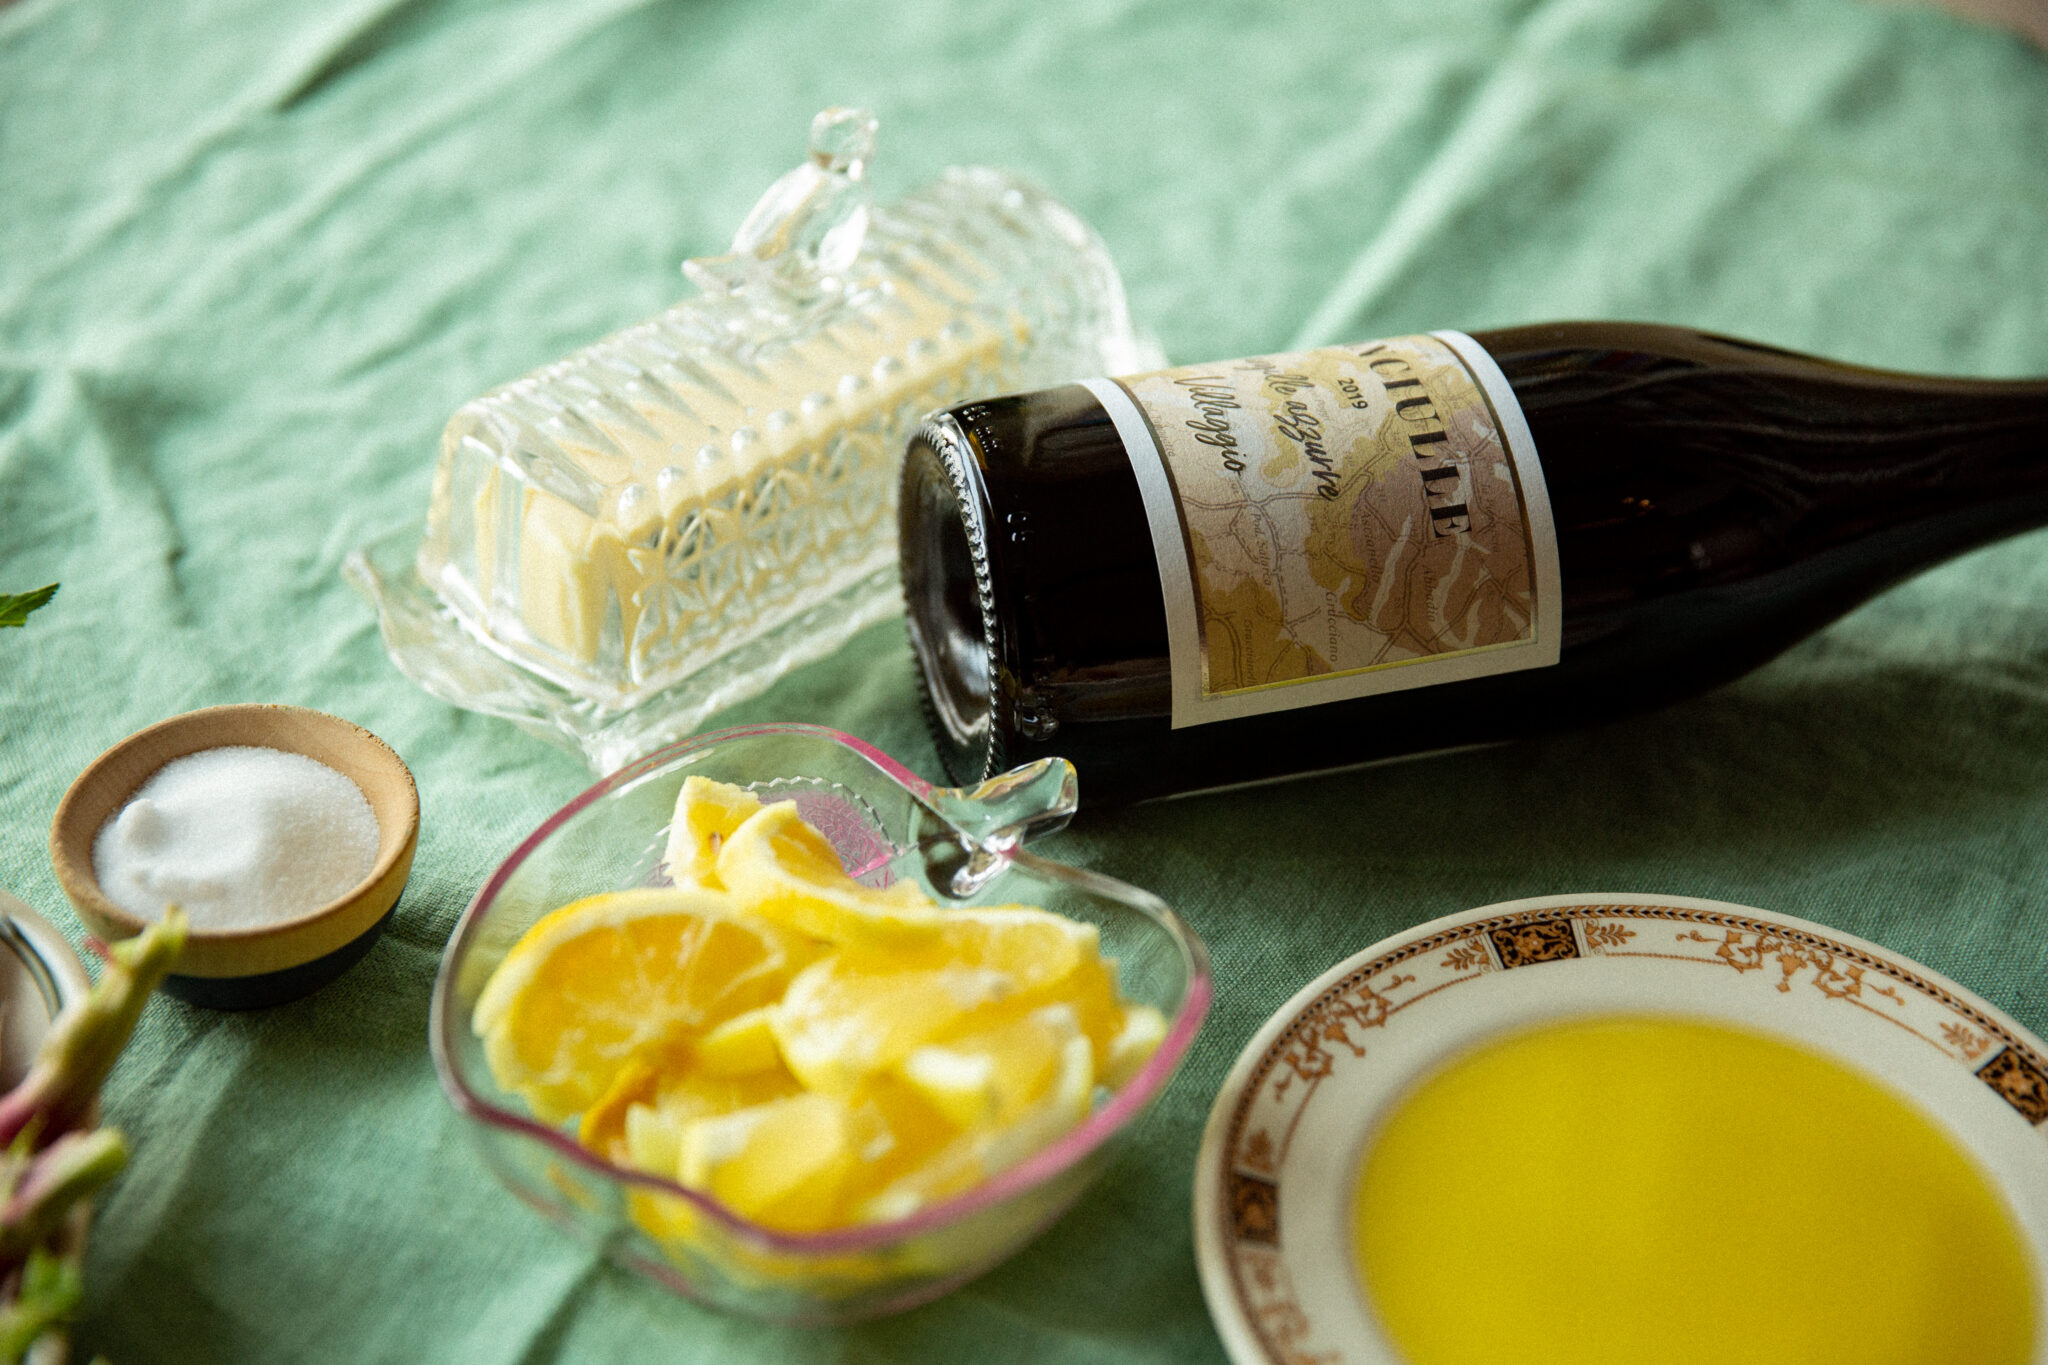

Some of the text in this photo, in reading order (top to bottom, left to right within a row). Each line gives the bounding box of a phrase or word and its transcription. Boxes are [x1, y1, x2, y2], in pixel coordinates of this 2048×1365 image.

[1173, 376, 1247, 477] Villaggio
[1337, 377, 1369, 410] 2019
[1326, 591, 1341, 663] Gracciano
